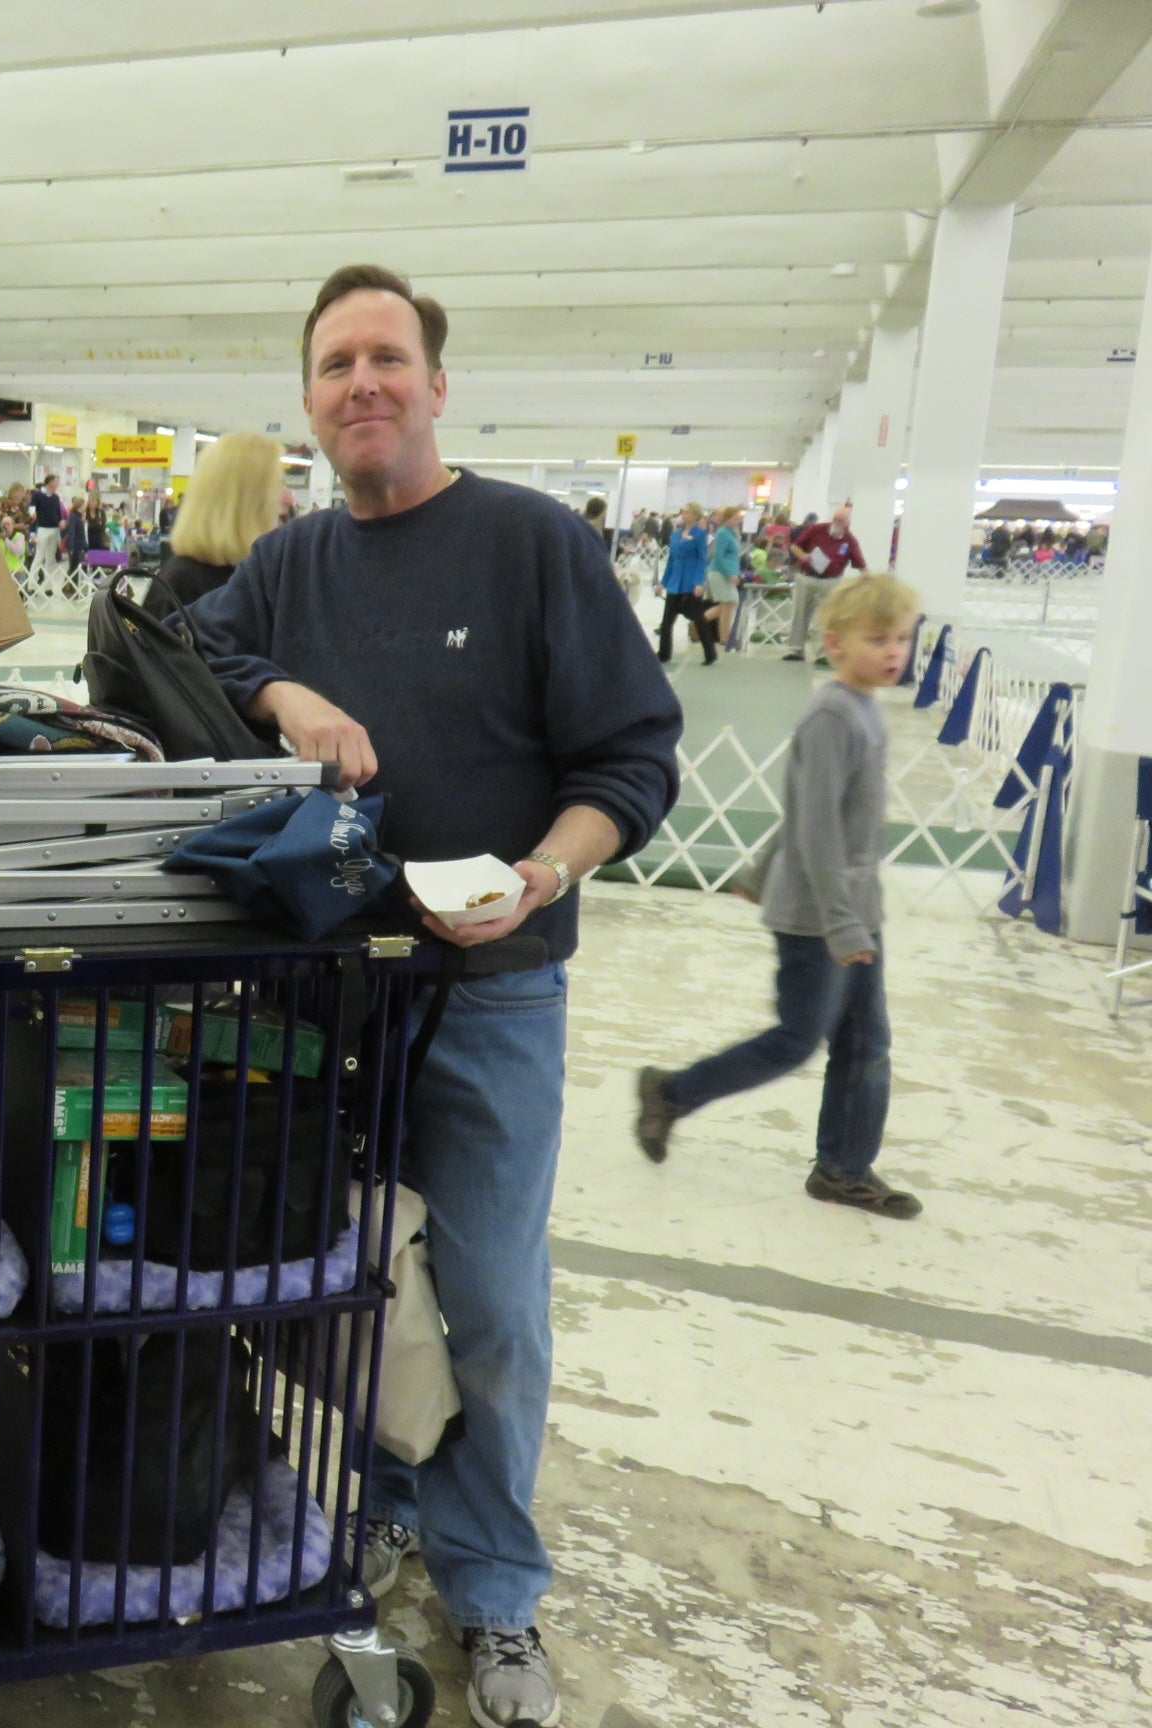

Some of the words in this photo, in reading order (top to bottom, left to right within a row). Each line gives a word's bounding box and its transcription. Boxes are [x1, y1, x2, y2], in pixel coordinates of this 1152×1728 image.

[448, 123, 527, 157] H-10
[617, 437, 633, 453] 15
[54, 1089, 67, 1127] IAMS
[51, 1262, 86, 1274] IAMS
